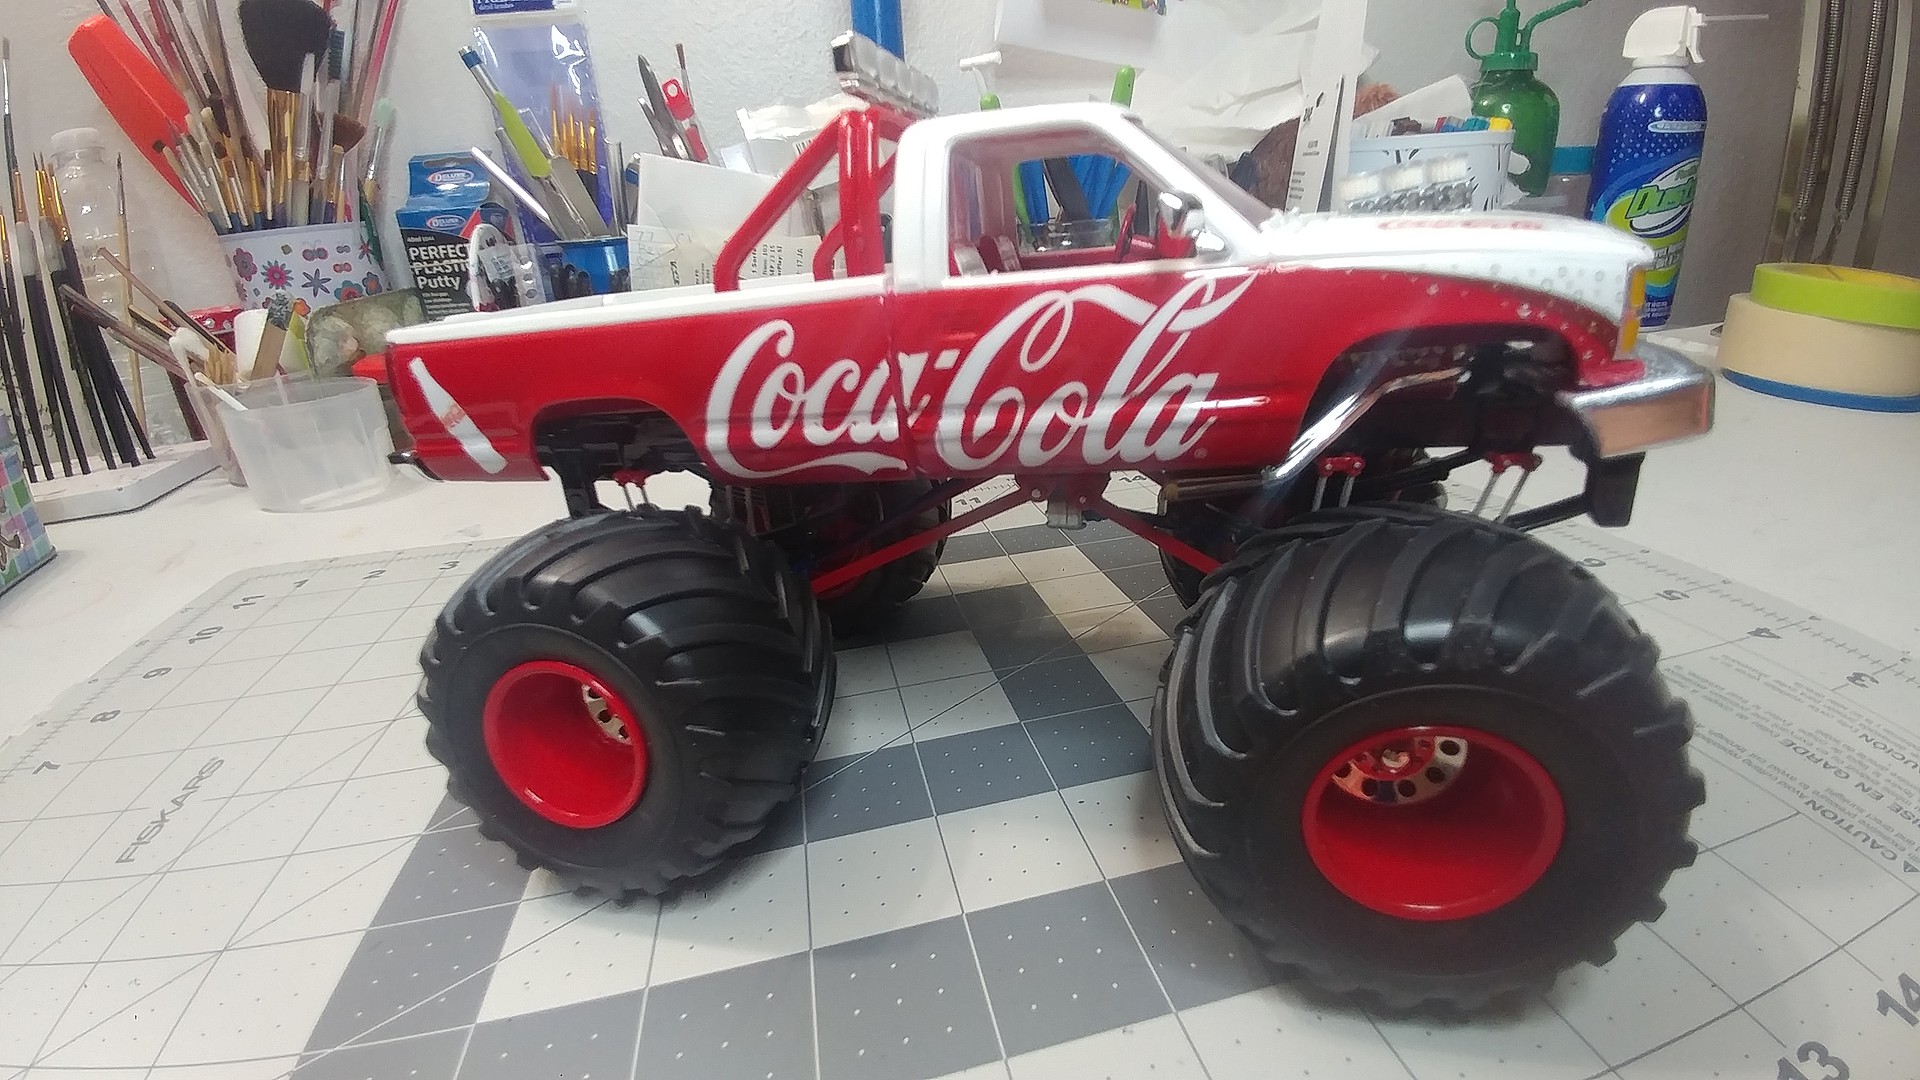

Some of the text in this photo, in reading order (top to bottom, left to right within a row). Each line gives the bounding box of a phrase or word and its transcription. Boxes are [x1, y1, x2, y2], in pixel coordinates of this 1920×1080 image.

[408, 243, 470, 261] PERFECT
[417, 275, 461, 290] Putty
[705, 268, 1258, 479] Coca-Cola
[439, 560, 460, 570] 3
[363, 569, 387, 580] 2
[233, 595, 265, 609] 11
[1655, 589, 1690, 601] 5
[188, 626, 223, 645] 10
[1747, 627, 1782, 639] 4
[142, 667, 172, 680] 9
[1846, 672, 1880, 688] 3
[90, 710, 121, 724] 8
[1779, 739, 1850, 779] GARDE
[32, 761, 61, 775] 7
[1854, 782, 1884, 801] EN
[115, 757, 224, 863] FISKARS
[1804, 799, 1897, 861] CAUTION
